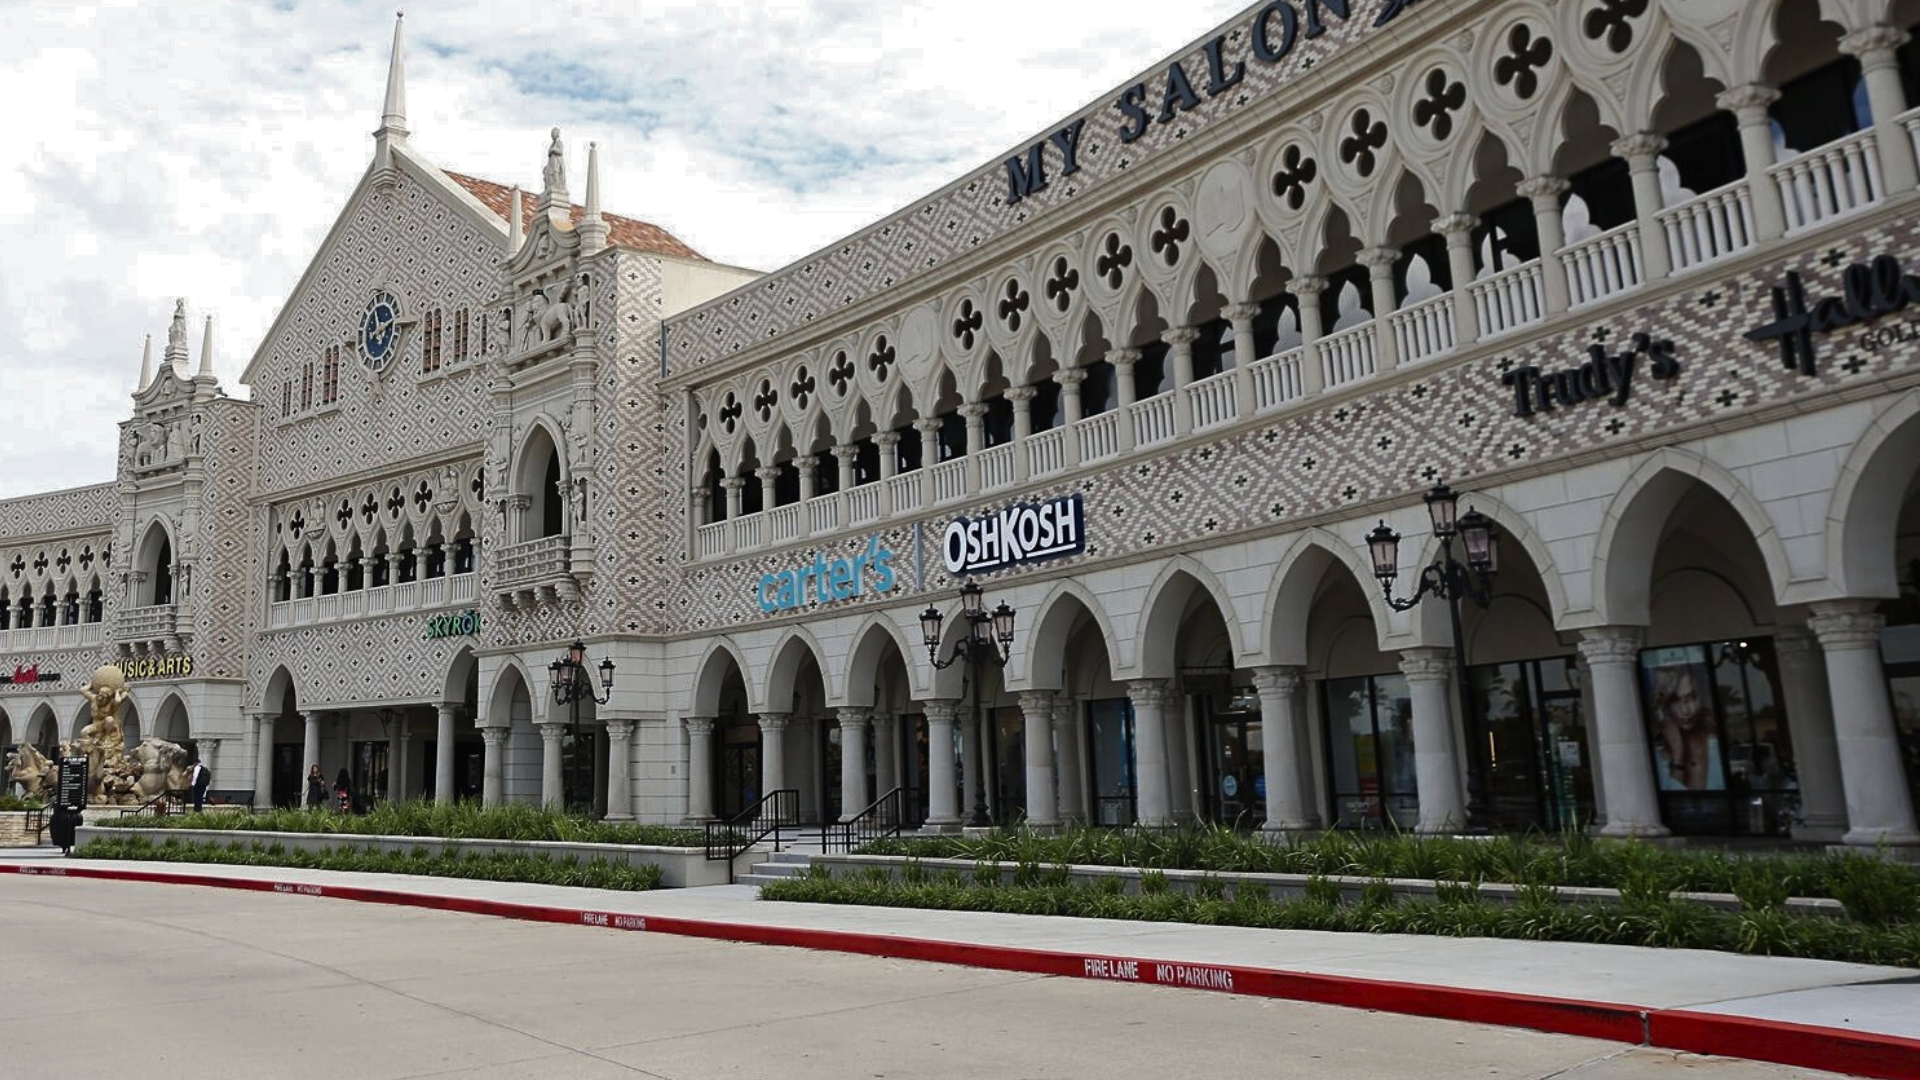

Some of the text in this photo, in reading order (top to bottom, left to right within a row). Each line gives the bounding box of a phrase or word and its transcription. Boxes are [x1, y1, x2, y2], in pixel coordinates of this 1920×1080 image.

[1004, 119, 1085, 204] MY
[1502, 332, 1680, 417] Trudy's
[757, 534, 897, 612] carter's
[944, 498, 1078, 573] OSHKOSH
[115, 655, 192, 678] USIC & ARTS
[1084, 958, 1234, 990] FIRE LANE NO PARKING
